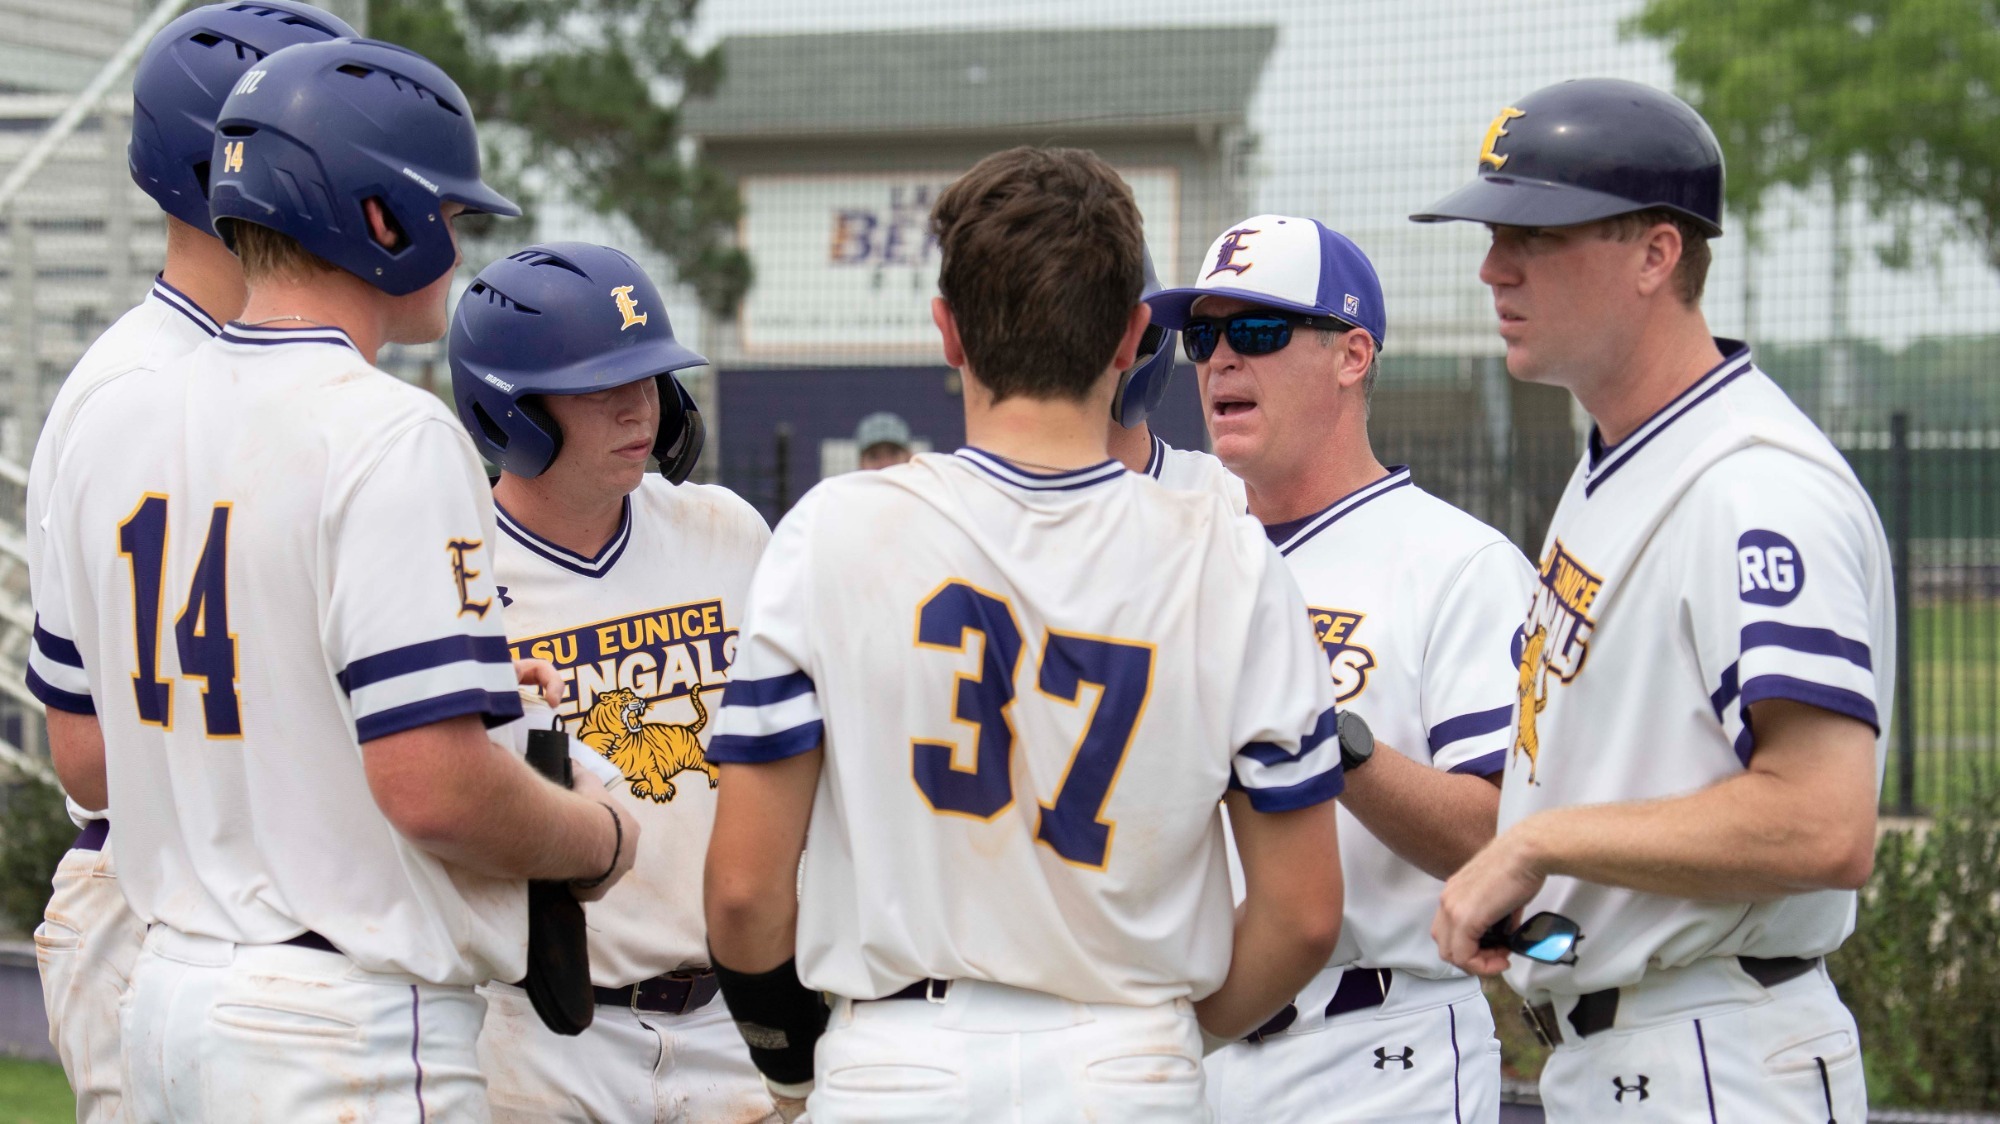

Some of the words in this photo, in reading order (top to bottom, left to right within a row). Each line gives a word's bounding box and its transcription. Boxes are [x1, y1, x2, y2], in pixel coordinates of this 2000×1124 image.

[224, 141, 244, 173] 14
[1480, 107, 1527, 171] E
[403, 167, 439, 193] marucci
[1205, 228, 1262, 281] E
[610, 285, 647, 331] E
[485, 373, 515, 392] marucci
[445, 537, 493, 621] E
[1738, 545, 1795, 593] RG
[117, 491, 244, 741] 14
[595, 605, 721, 655] EUNICE
[541, 634, 740, 716] ENGAL
[910, 577, 1157, 873] 37
